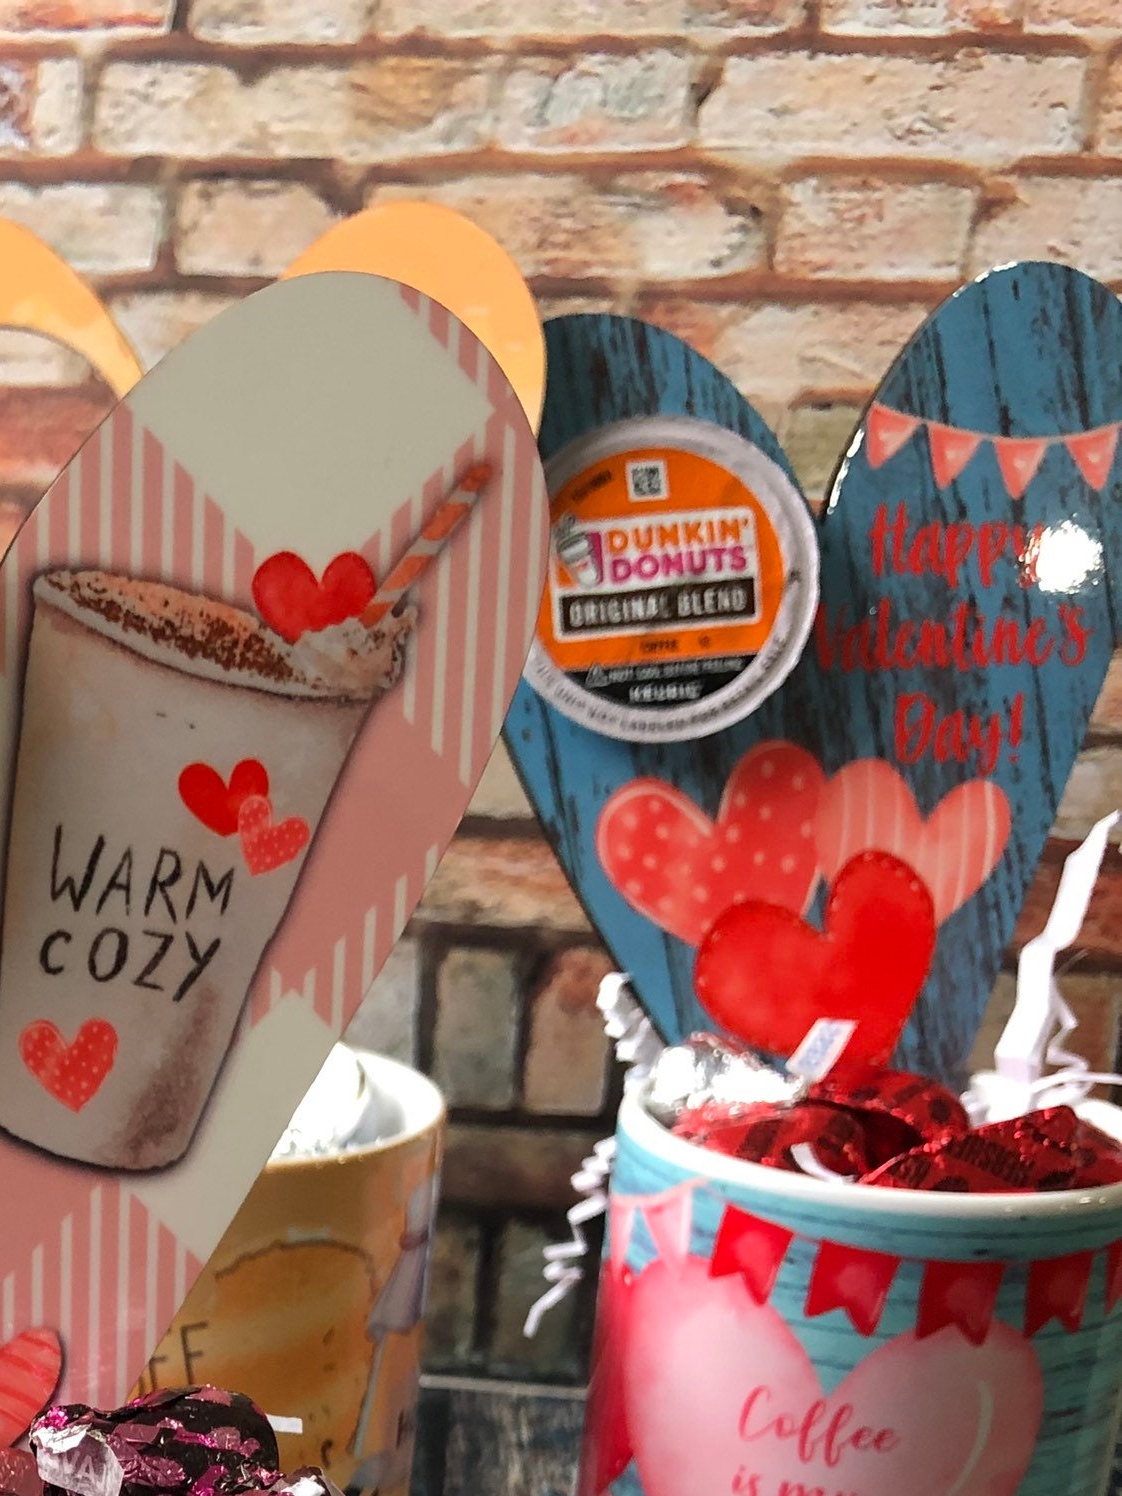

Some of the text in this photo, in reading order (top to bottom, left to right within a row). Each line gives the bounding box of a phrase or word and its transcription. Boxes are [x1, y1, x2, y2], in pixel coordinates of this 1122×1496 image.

[607, 517, 750, 554] DUNKIN'
[609, 545, 747, 584] DONUTS
[868, 499, 1046, 590] Happy
[568, 586, 748, 628] ORIGINAL BLEND
[814, 596, 1095, 673] Valentine's
[893, 691, 1025, 780] Day!
[50, 822, 235, 924] WARM
[39, 927, 222, 1003] COZY
[738, 1385, 901, 1468] Coffee
